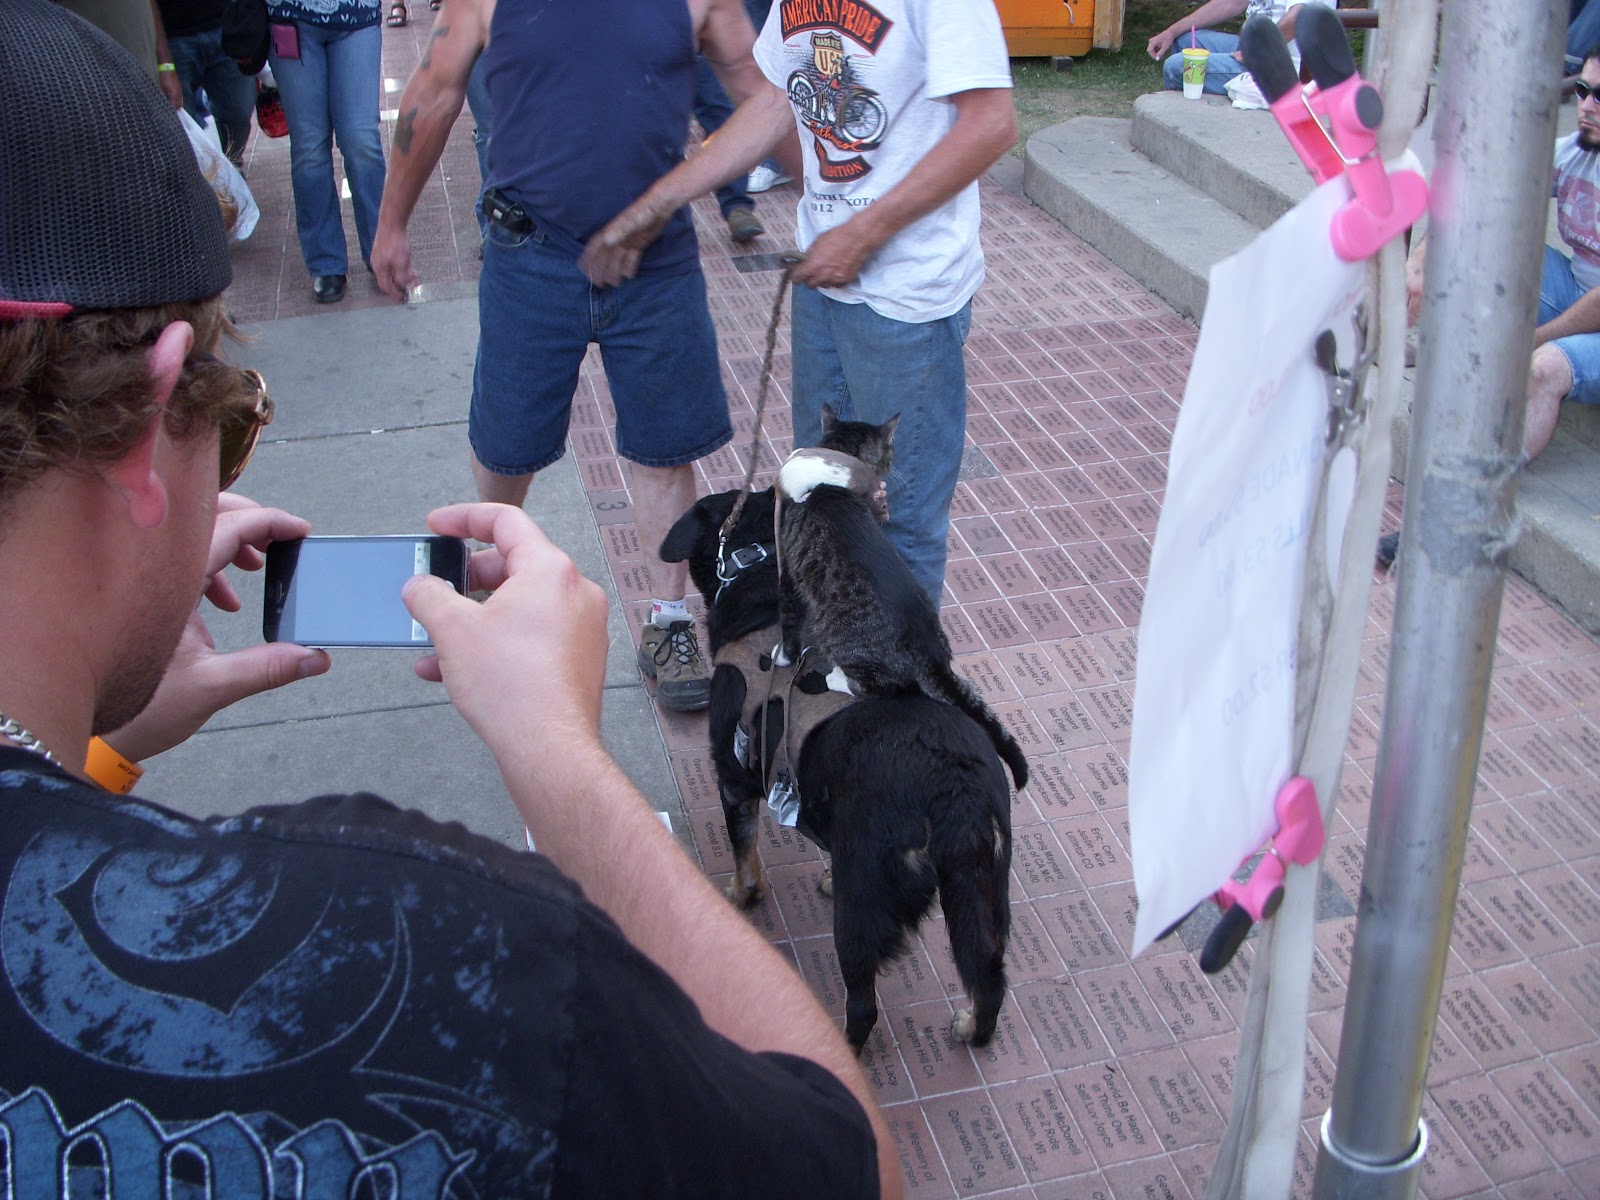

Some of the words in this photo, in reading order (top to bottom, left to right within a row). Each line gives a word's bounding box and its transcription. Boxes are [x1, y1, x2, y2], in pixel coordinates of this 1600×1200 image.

[782, 0, 839, 33] AMERICAN
[838, 0, 882, 44] PRIDE
[594, 499, 628, 512] 3
[1067, 701, 1081, 712] Ron
[1084, 762, 1110, 790] California
[1097, 762, 1120, 785] Fontana
[1080, 857, 1094, 869] CO
[1116, 980, 1133, 995] Ron
[1192, 984, 1210, 998] and
[1027, 996, 1042, 1010] Our
[1042, 994, 1057, 1008] For
[1179, 1012, 1196, 1025] SD
[1066, 1010, 1083, 1026] and
[1075, 1028, 1096, 1050] Ross
[922, 1064, 937, 1078] CA
[1040, 1089, 1060, 1111] Mike
[1090, 1083, 1102, 1092] in
[1109, 1119, 1129, 1141] Own
[1164, 1109, 1181, 1124] SD
[1090, 1120, 1116, 1149] Joyce
[1121, 1115, 1148, 1145] Happy
[1043, 1128, 1063, 1150] Ride
[967, 1155, 987, 1178] USA
[923, 1170, 936, 1181] of
